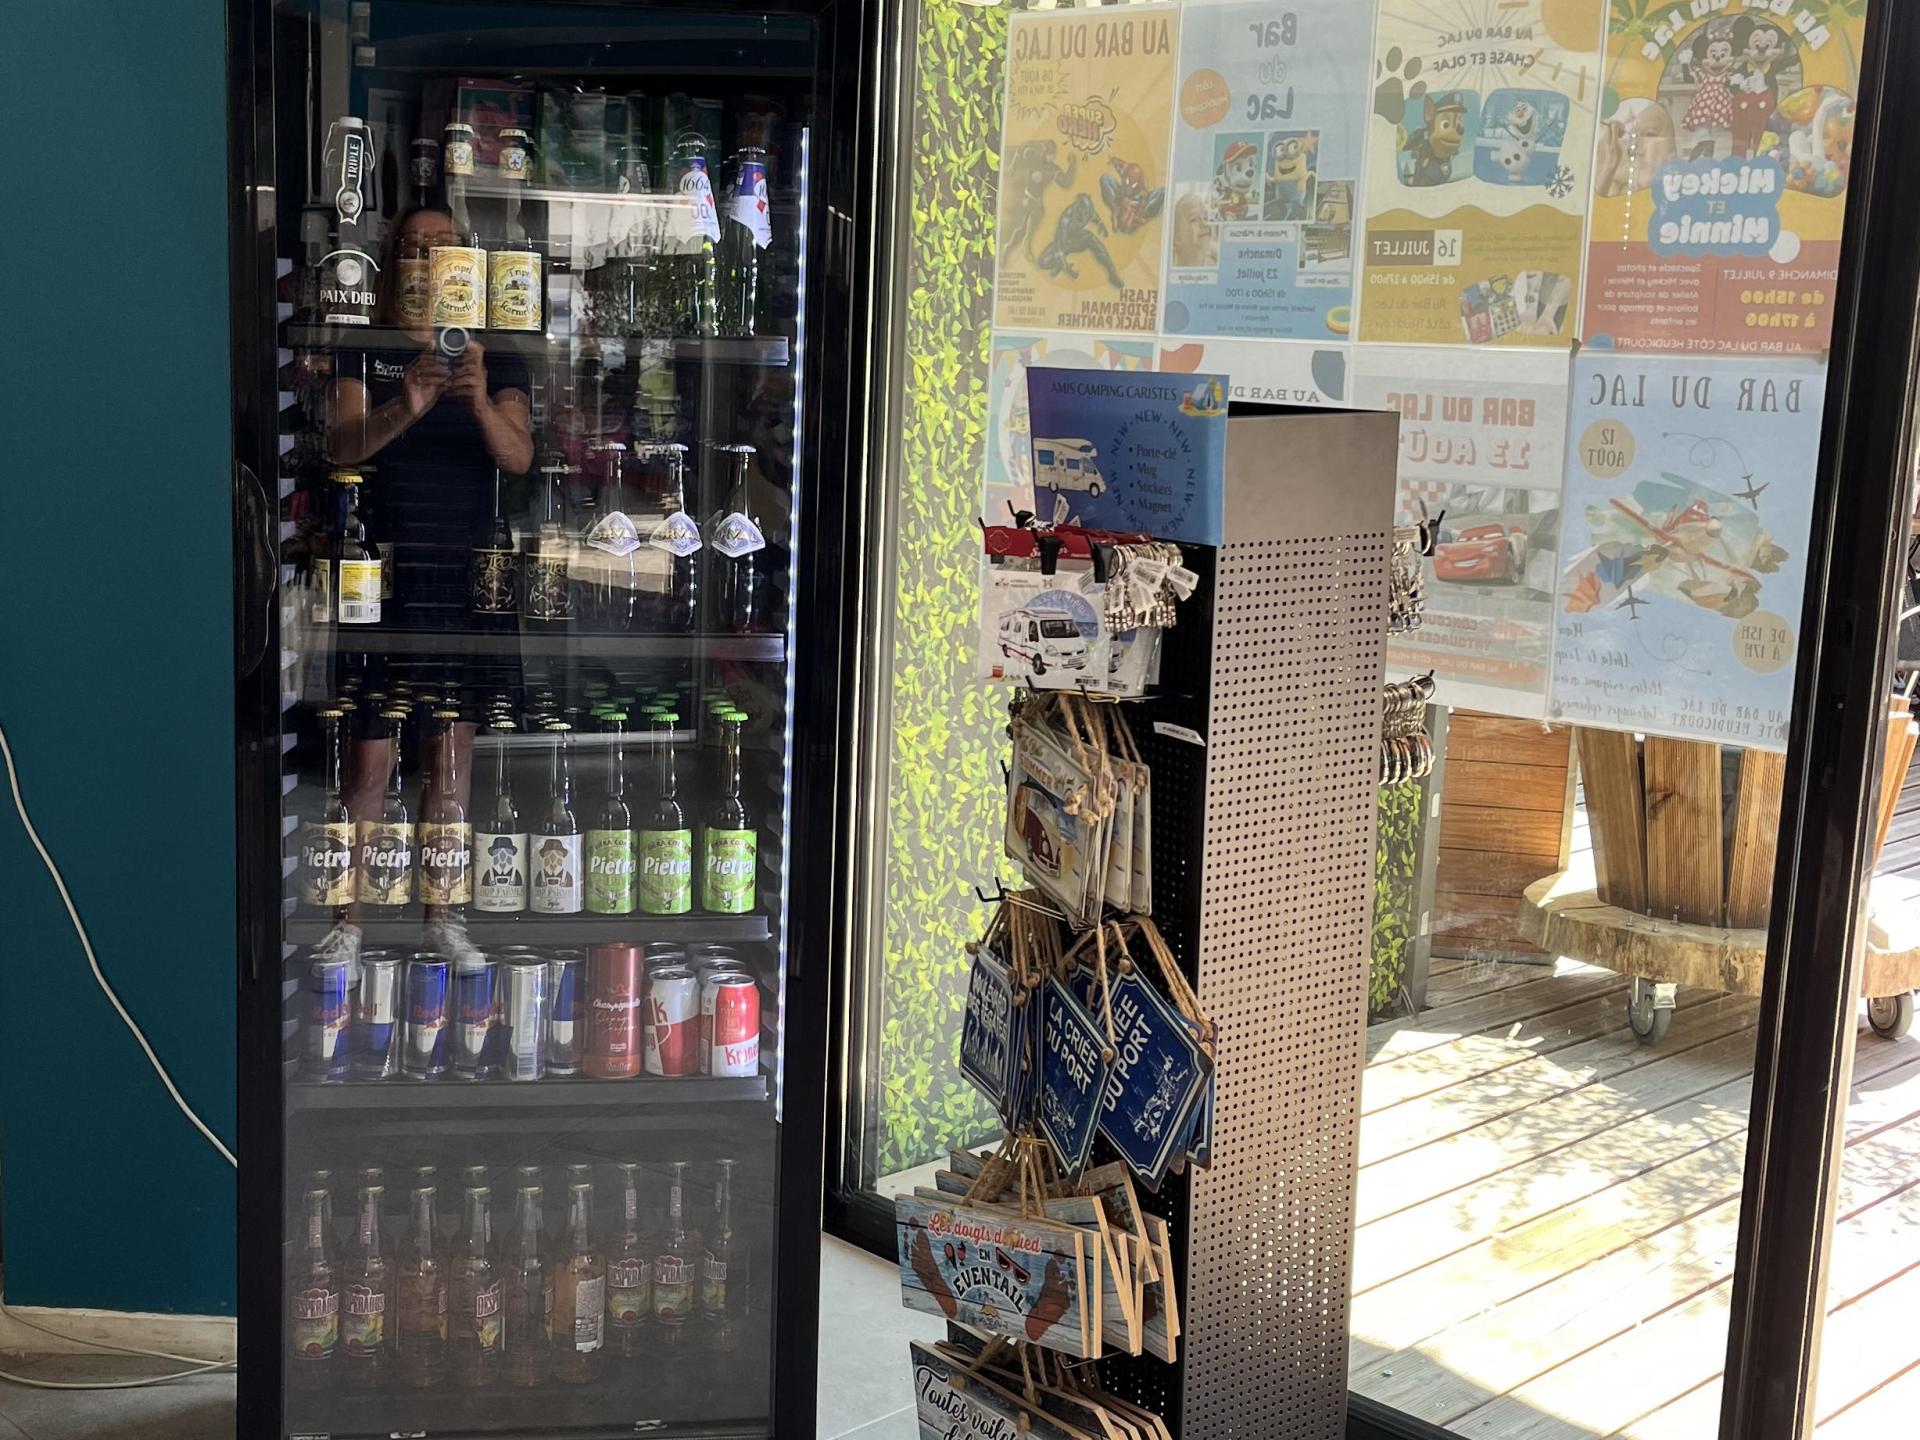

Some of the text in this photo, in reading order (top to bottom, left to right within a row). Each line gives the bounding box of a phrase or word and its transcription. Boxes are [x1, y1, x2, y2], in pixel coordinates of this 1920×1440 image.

[347, 142, 359, 179] TRIPLE
[681, 176, 710, 192] 1664
[320, 289, 376, 306] PAIX DIEU
[1051, 381, 1177, 401] AMIS CAMPING CARISTES
[1135, 410, 1162, 423] NEW
[1137, 462, 1157, 479] Mug
[302, 845, 351, 868] Pietra
[362, 845, 411, 868] Pietra
[421, 845, 470, 867] Pietra
[590, 855, 637, 875] Pietra
[644, 856, 690, 875] Pietra
[707, 855, 753, 876] Pietra
[1050, 996, 1098, 1074] LA CRIÉE
[1116, 1013, 1152, 1080] PORT
[1060, 1043, 1091, 1095] PORT
[954, 1220, 992, 1247] doigts
[979, 1248, 991, 1261] EN
[953, 1266, 1024, 1314] EVENTAIL
[916, 1367, 968, 1422] Toutes
